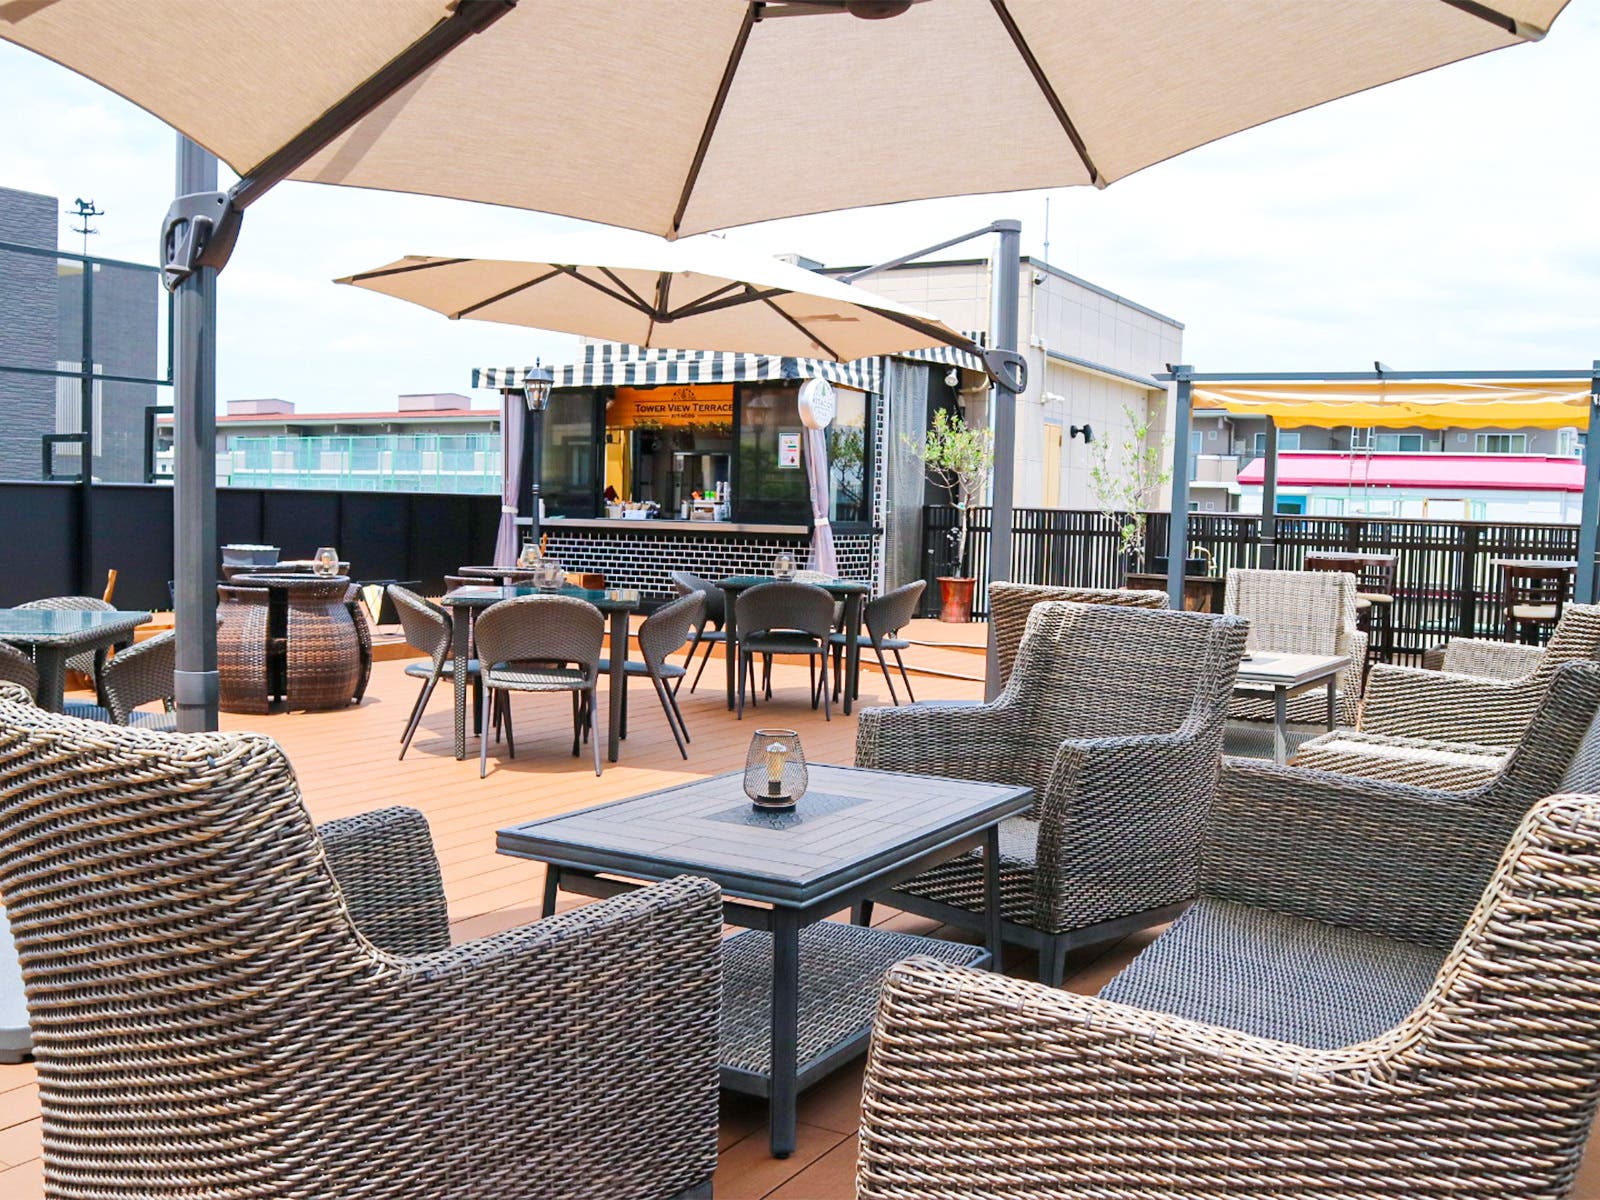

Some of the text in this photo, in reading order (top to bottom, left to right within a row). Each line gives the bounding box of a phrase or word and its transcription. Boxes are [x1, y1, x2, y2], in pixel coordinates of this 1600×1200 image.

[635, 402, 734, 413] TOWER VIEW TERRACE
